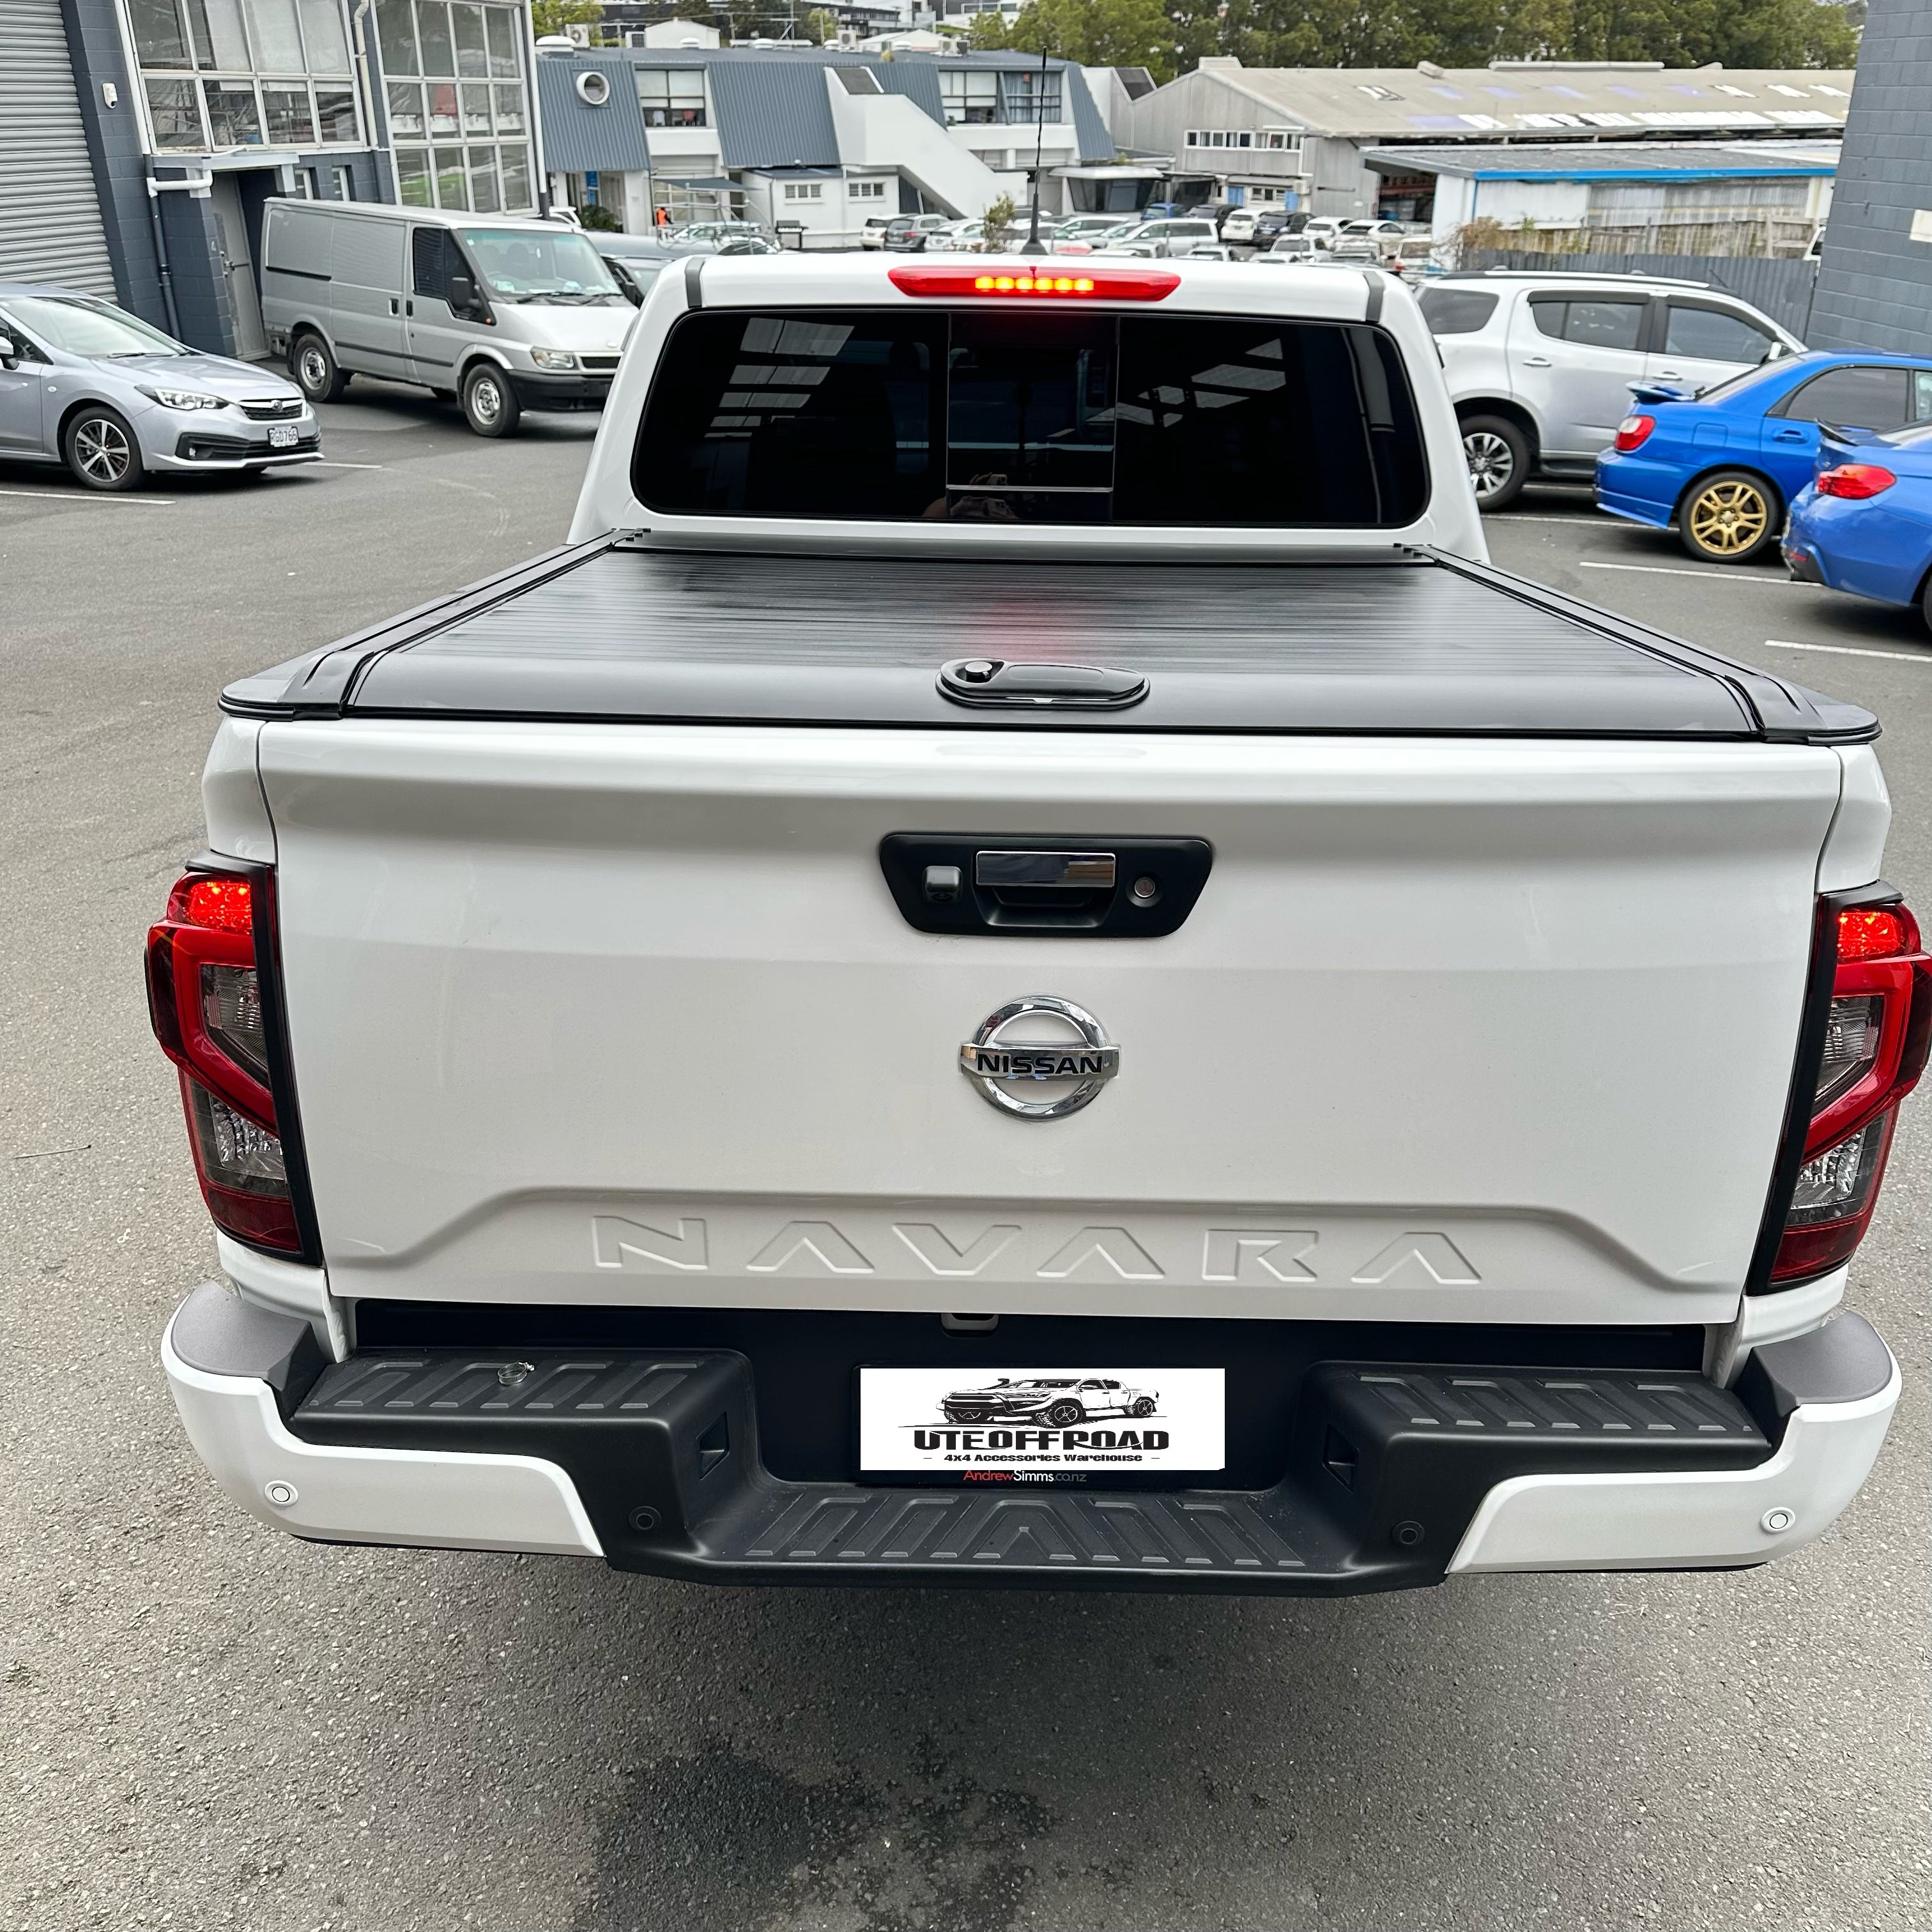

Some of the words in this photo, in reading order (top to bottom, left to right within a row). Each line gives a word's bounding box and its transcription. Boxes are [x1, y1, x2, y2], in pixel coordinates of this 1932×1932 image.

[977, 1054, 1102, 1075] NISSAN
[592, 1215, 1482, 1284] NAVARA
[963, 1469, 1087, 1482] AndrewSimms.co.nz
